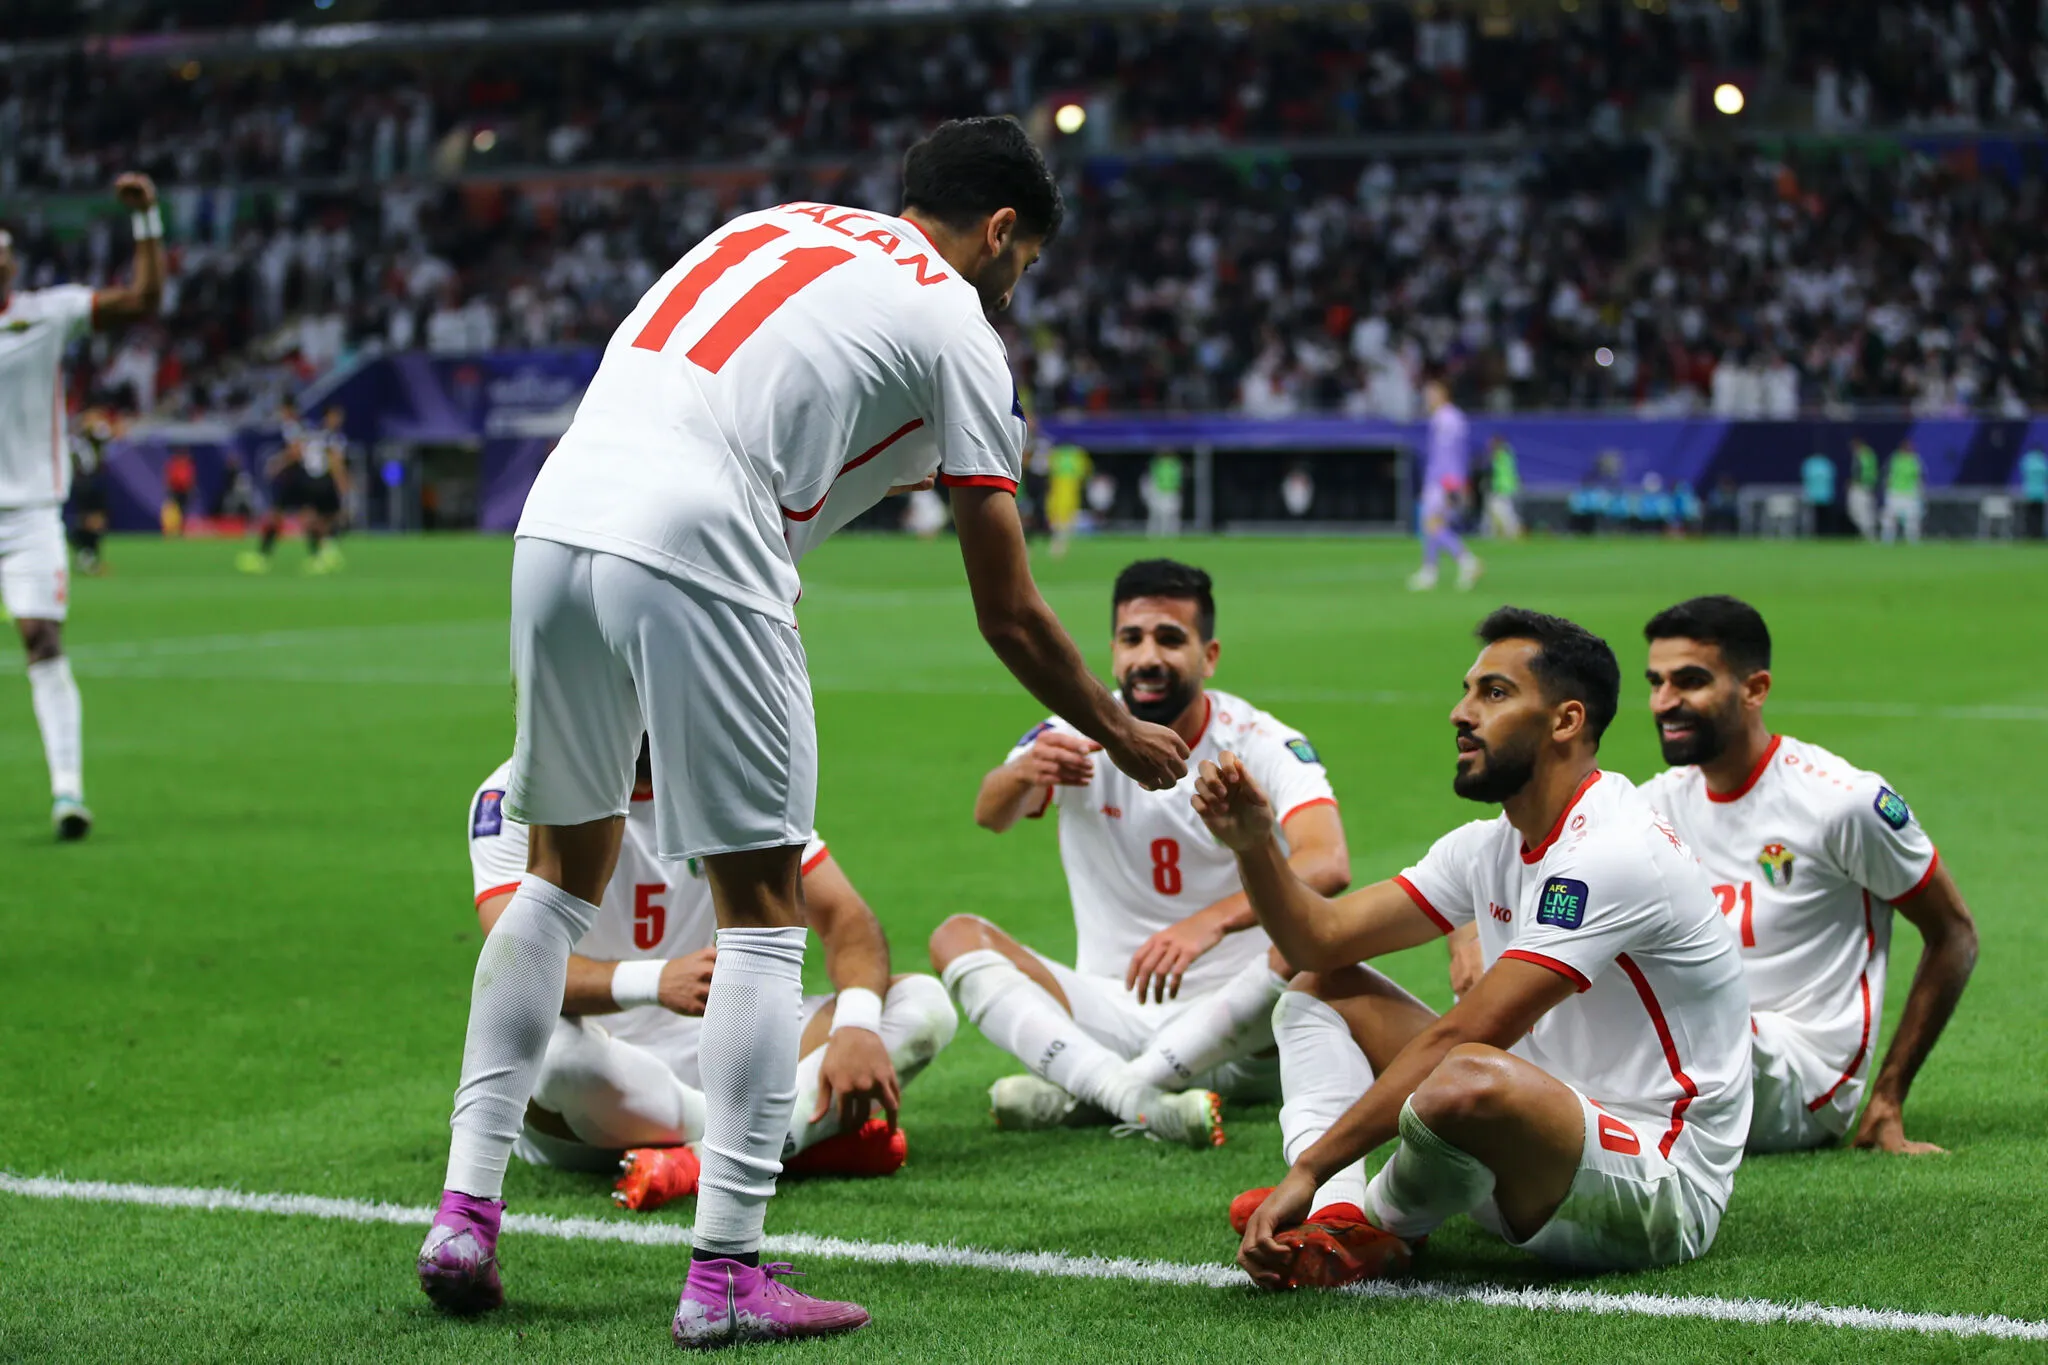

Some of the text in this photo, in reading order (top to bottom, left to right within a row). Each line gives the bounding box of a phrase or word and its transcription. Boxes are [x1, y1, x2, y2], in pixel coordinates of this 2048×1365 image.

[631, 223, 857, 375] 11
[1150, 837, 1183, 896] 8
[1548, 884, 1568, 894] AFC
[633, 883, 667, 951] 5
[1545, 893, 1580, 909] LIVE
